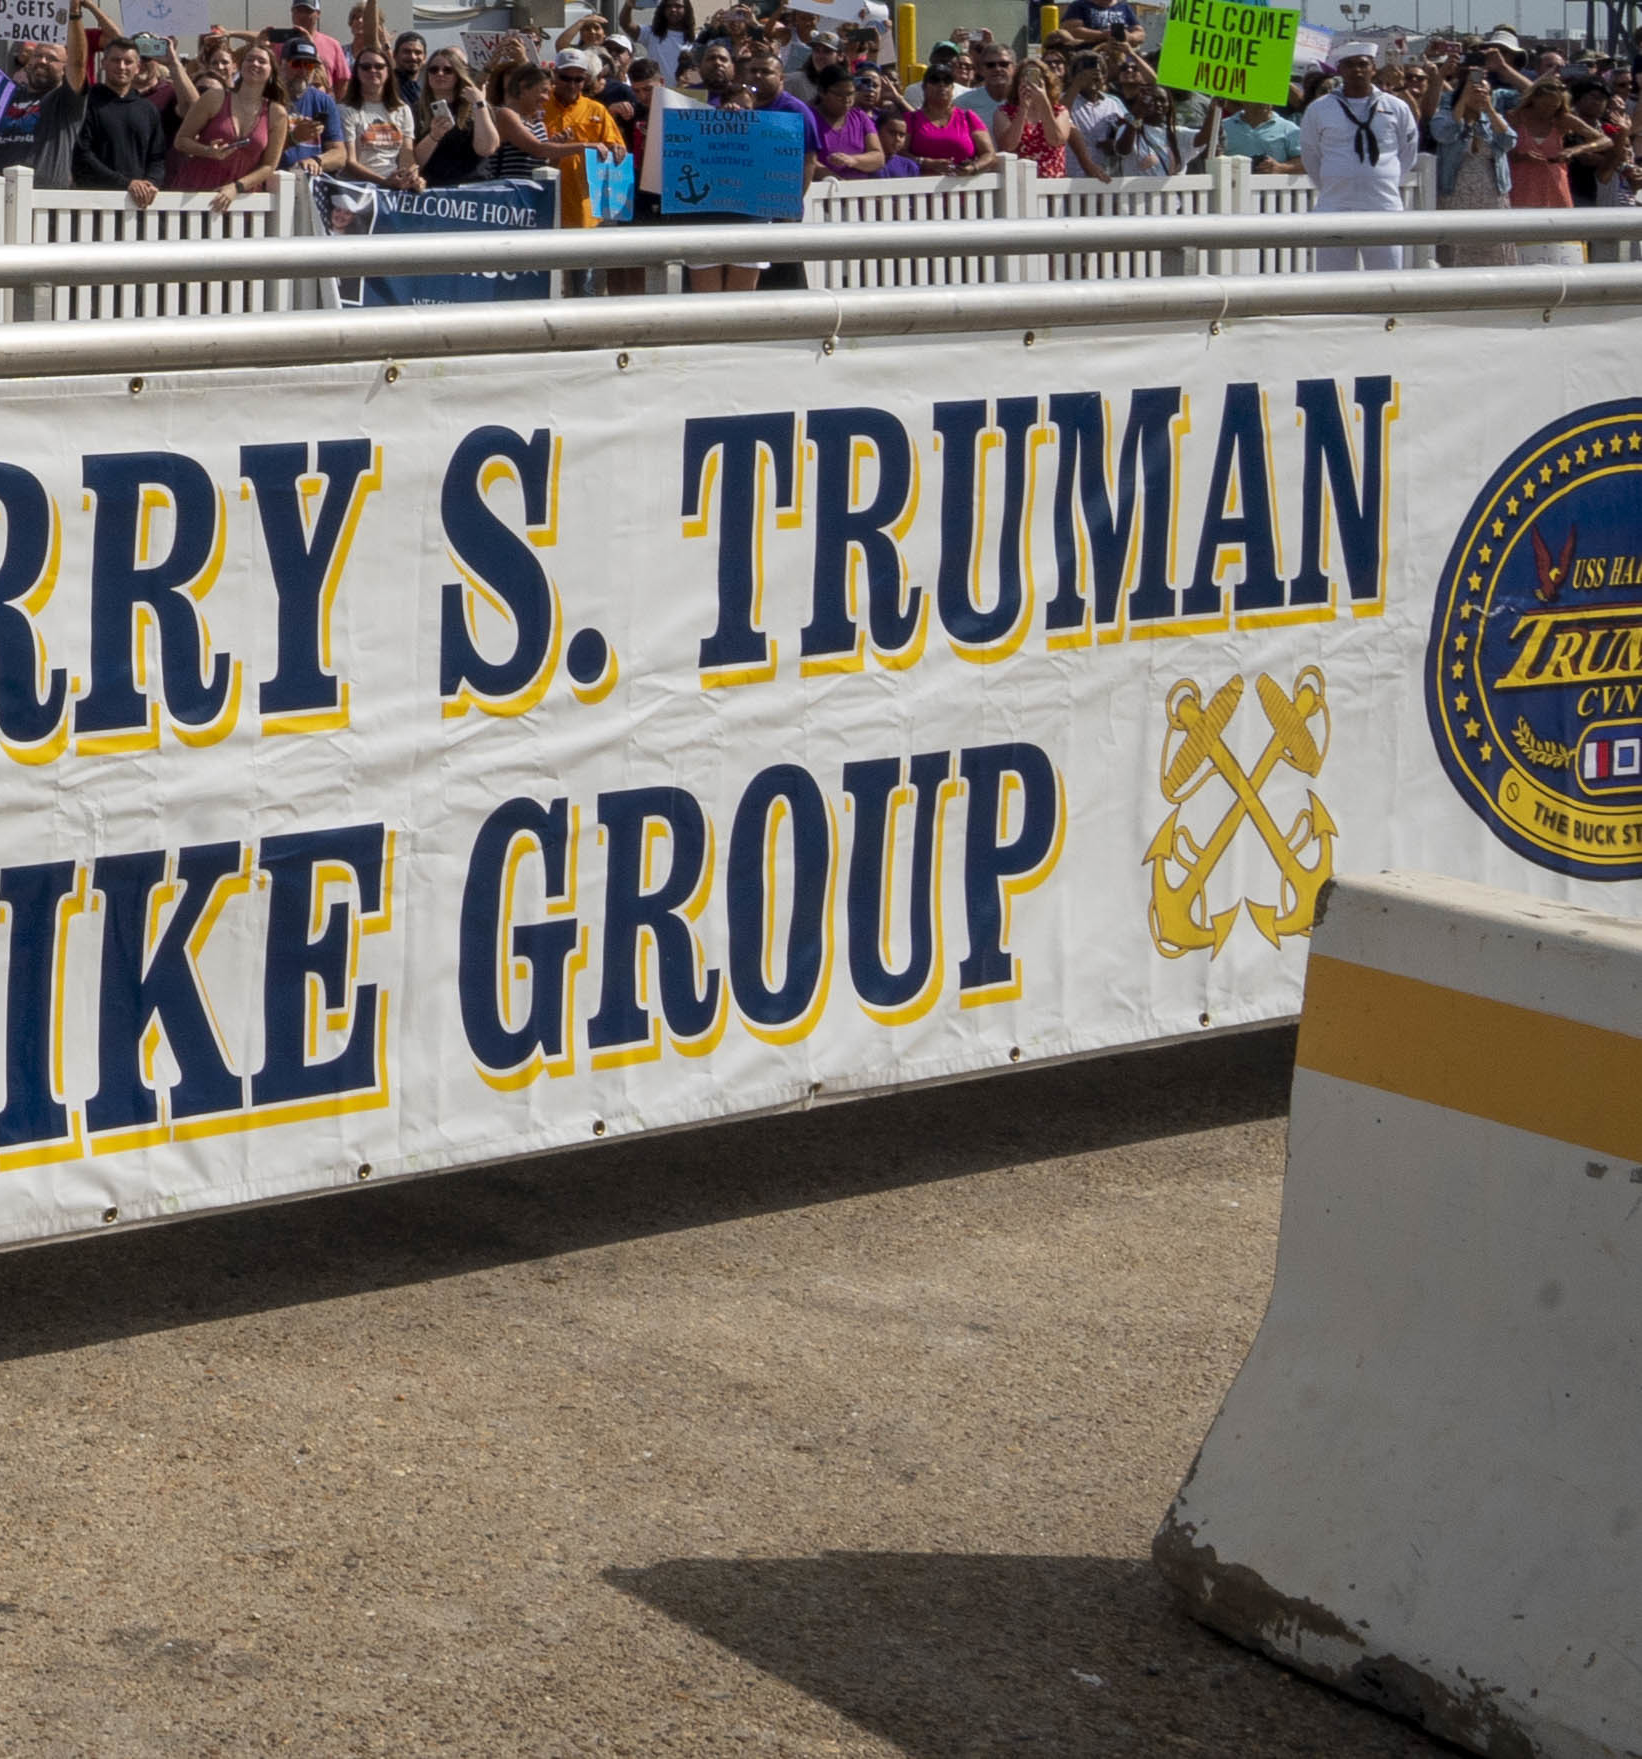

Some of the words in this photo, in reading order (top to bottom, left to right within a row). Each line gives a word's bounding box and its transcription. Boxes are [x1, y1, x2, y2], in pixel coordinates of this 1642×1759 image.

[17, 0, 55, 18] GETS
[12, 24, 59, 42] BACK!
[1189, 28, 1261, 67] HOME
[1193, 61, 1247, 95] MOM
[678, 109, 761, 124] WELCOME
[700, 123, 750, 136] HOME
[383, 191, 478, 222] WELCOME
[482, 203, 537, 228] HOME
[439, 423, 618, 720] S.
[681, 373, 1400, 690] TRUMAN
[1572, 557, 1607, 590] USS
[1534, 800, 1570, 837] THE
[1573, 820, 1616, 845] BUCK
[456, 741, 1067, 1092] GROUP
